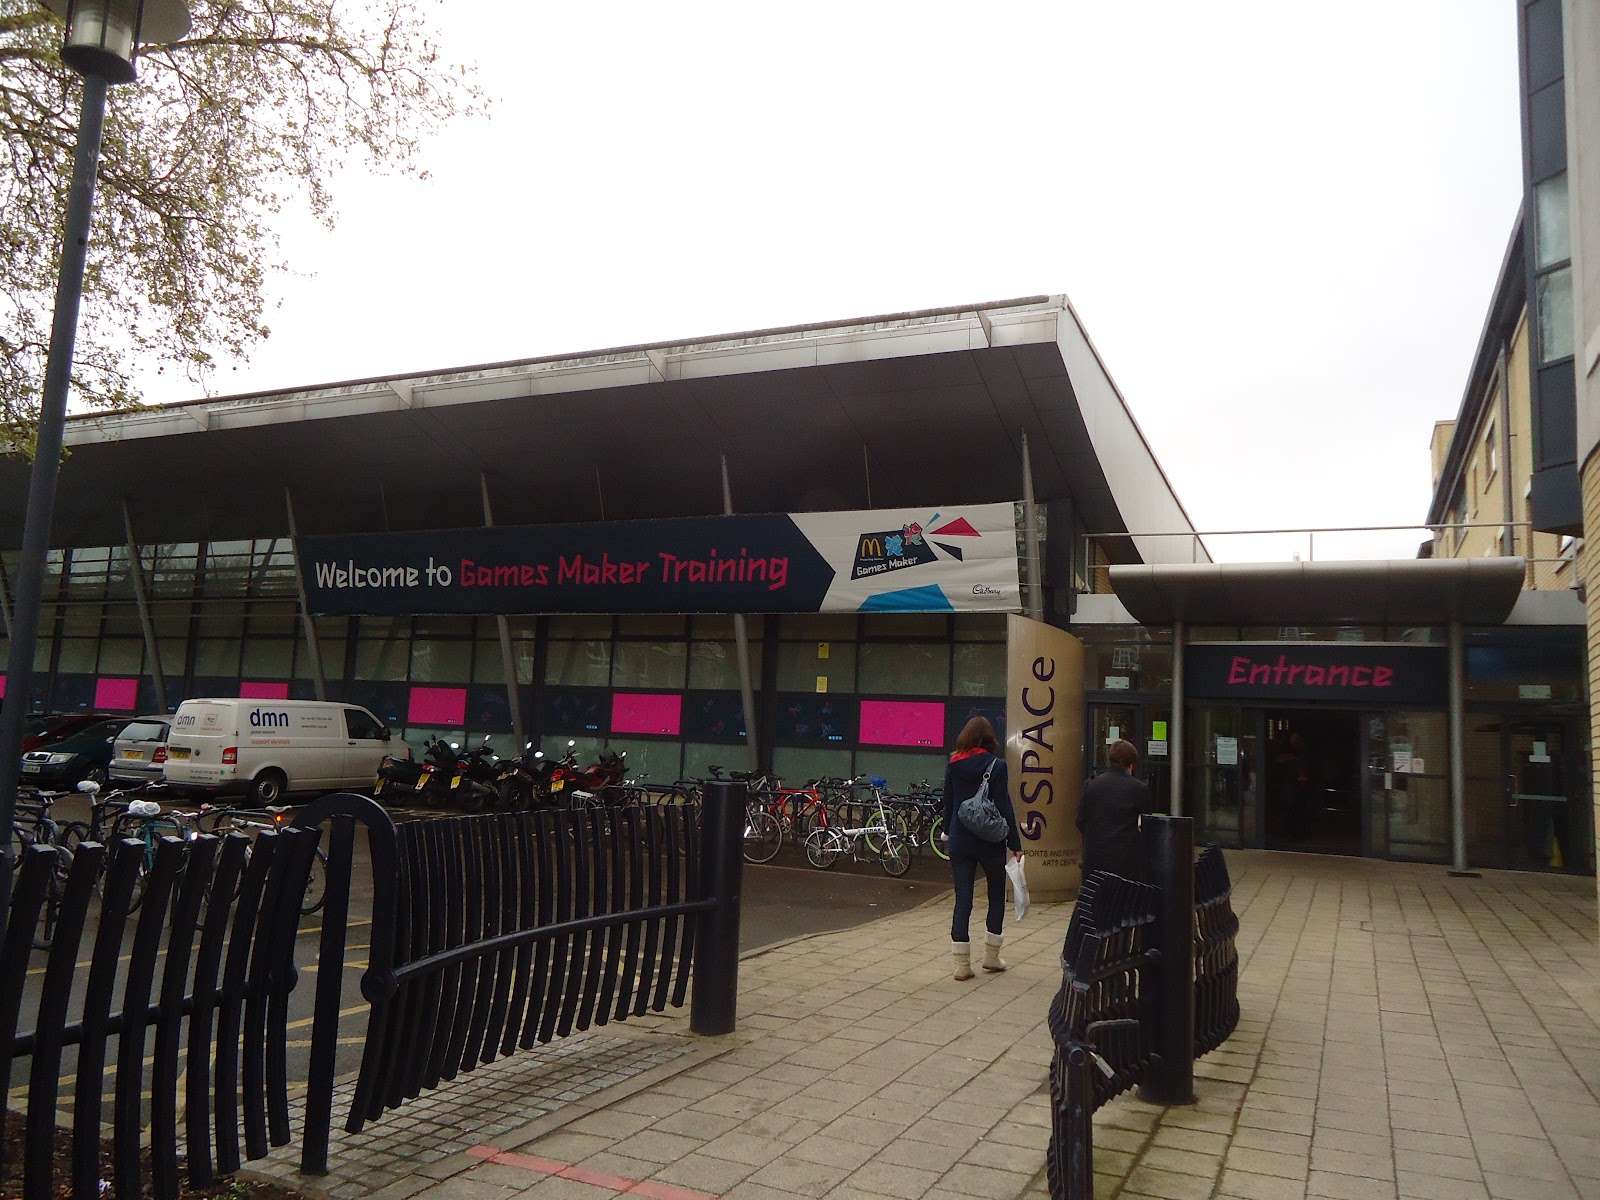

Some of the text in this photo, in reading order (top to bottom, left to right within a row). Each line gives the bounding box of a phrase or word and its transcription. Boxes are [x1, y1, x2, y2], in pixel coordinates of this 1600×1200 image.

[315, 547, 789, 592] Welcome to Games Maker Training
[856, 555, 919, 577] Games Maker
[972, 583, 1001, 596] Cadbury
[1227, 655, 1394, 688] Entrance
[177, 714, 196, 726] dmn
[250, 708, 289, 727] dmn
[1023, 850, 1048, 858] PORTS
